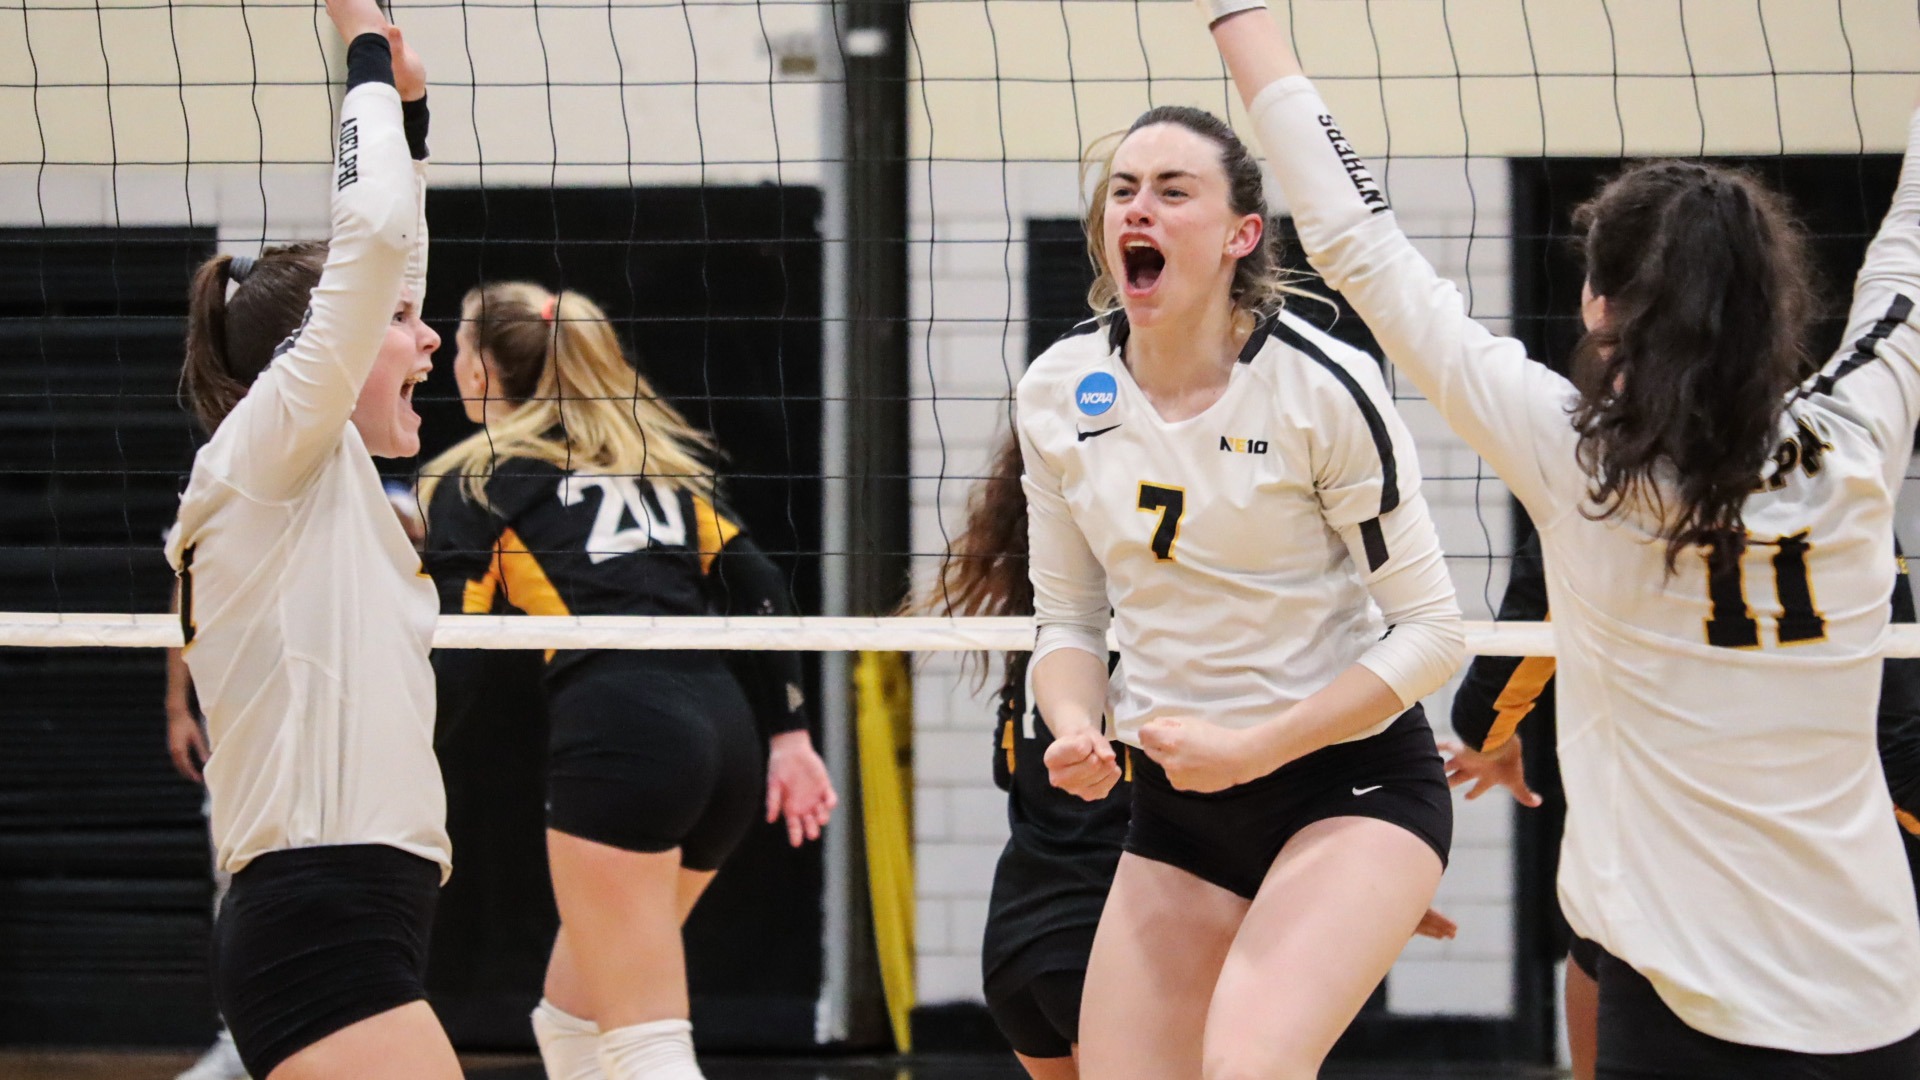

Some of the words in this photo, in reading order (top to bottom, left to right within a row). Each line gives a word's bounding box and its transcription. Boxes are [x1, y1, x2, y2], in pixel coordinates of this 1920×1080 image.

[337, 117, 358, 192] ADELPHI
[1080, 392, 1114, 404] NCAA
[1220, 435, 1268, 454] NE10
[556, 471, 686, 565] 20
[1136, 480, 1185, 563] 7
[1703, 526, 1829, 650] 11
